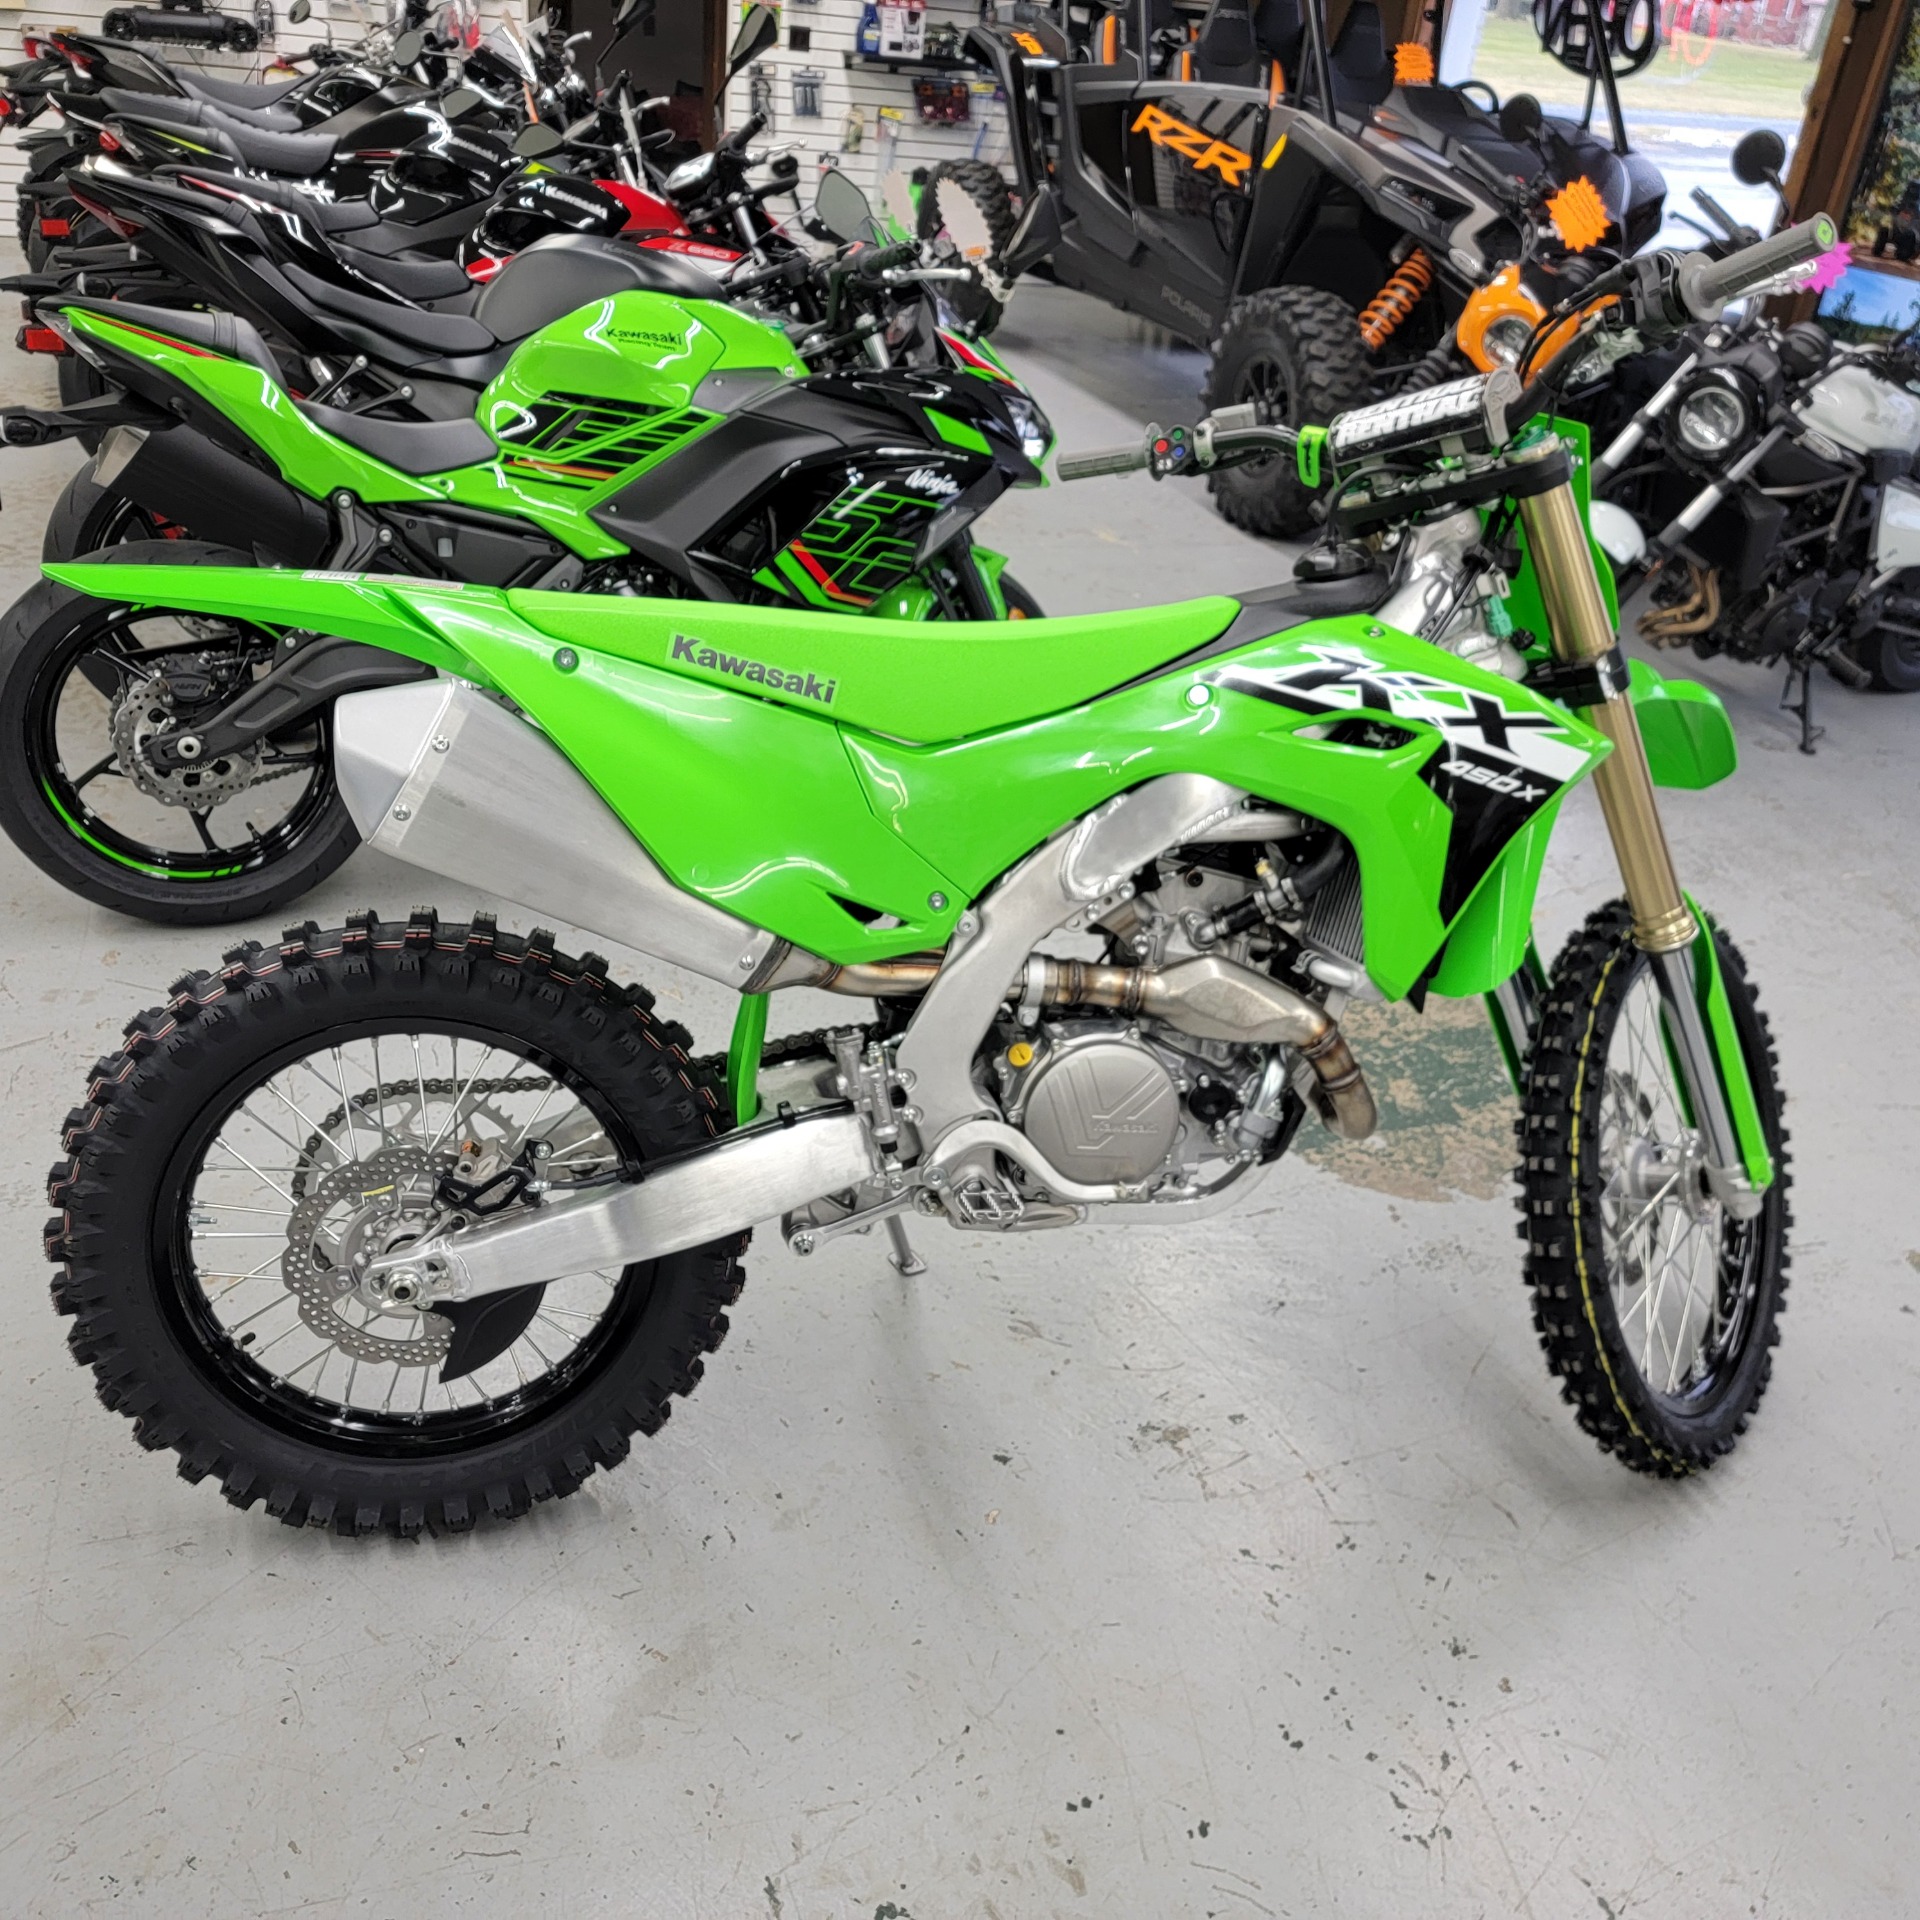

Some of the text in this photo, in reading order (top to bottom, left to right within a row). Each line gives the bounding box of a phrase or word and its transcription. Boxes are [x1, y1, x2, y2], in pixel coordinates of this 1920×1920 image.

[1130, 104, 1252, 187] RZR
[1161, 284, 1213, 329] POLARIS
[606, 327, 682, 346] Kawasaki
[1335, 386, 1485, 449] RENTHAL
[904, 469, 960, 496] Ninja
[671, 633, 837, 704] Kawasaki
